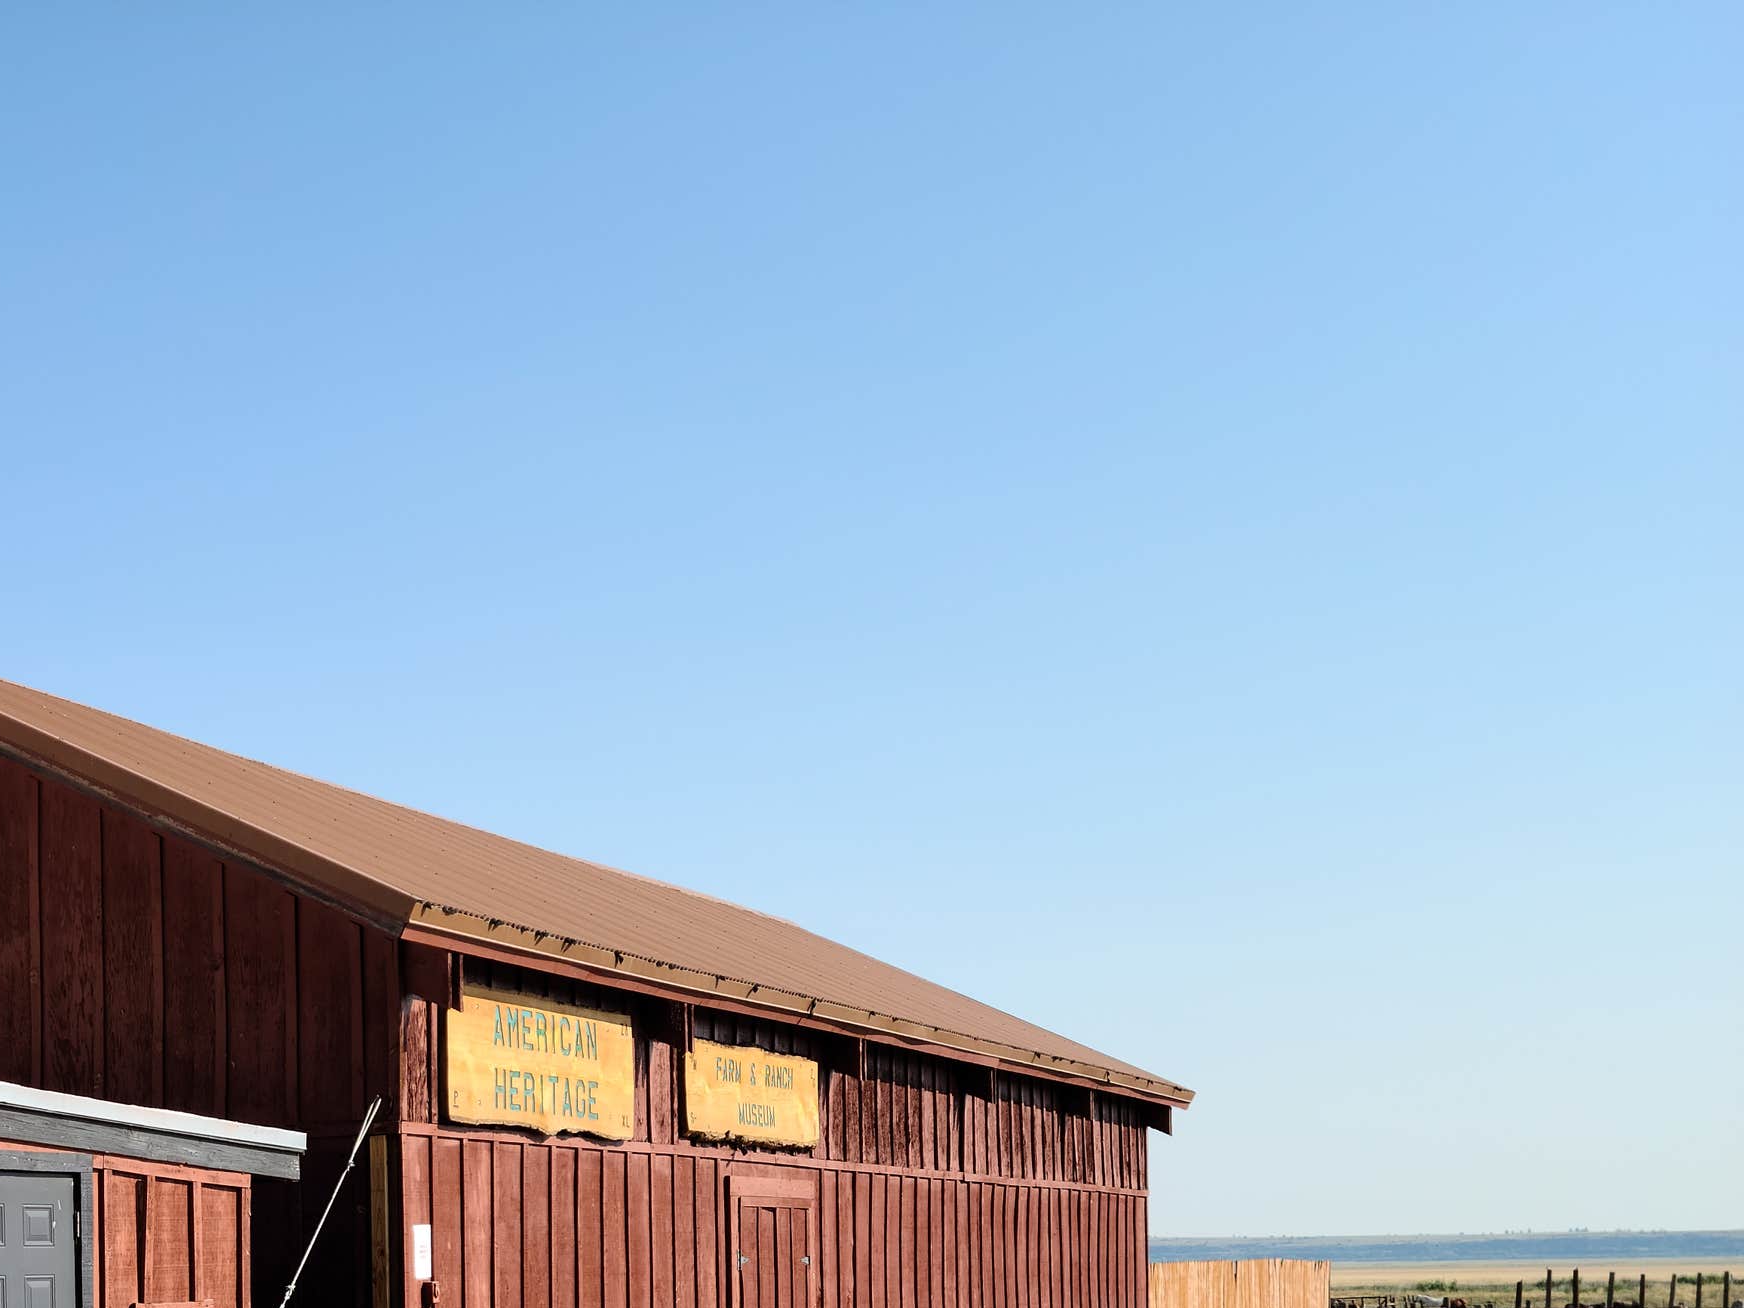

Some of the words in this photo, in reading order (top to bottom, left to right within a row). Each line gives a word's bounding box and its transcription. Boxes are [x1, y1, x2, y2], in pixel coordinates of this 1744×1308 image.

[493, 1004, 598, 1061] AMERICAN
[494, 1067, 599, 1121] HERITAGE
[716, 1057, 742, 1084] FARM
[750, 1062, 757, 1087] &
[765, 1064, 794, 1090] RANCH
[738, 1102, 776, 1129] MUSEUM
